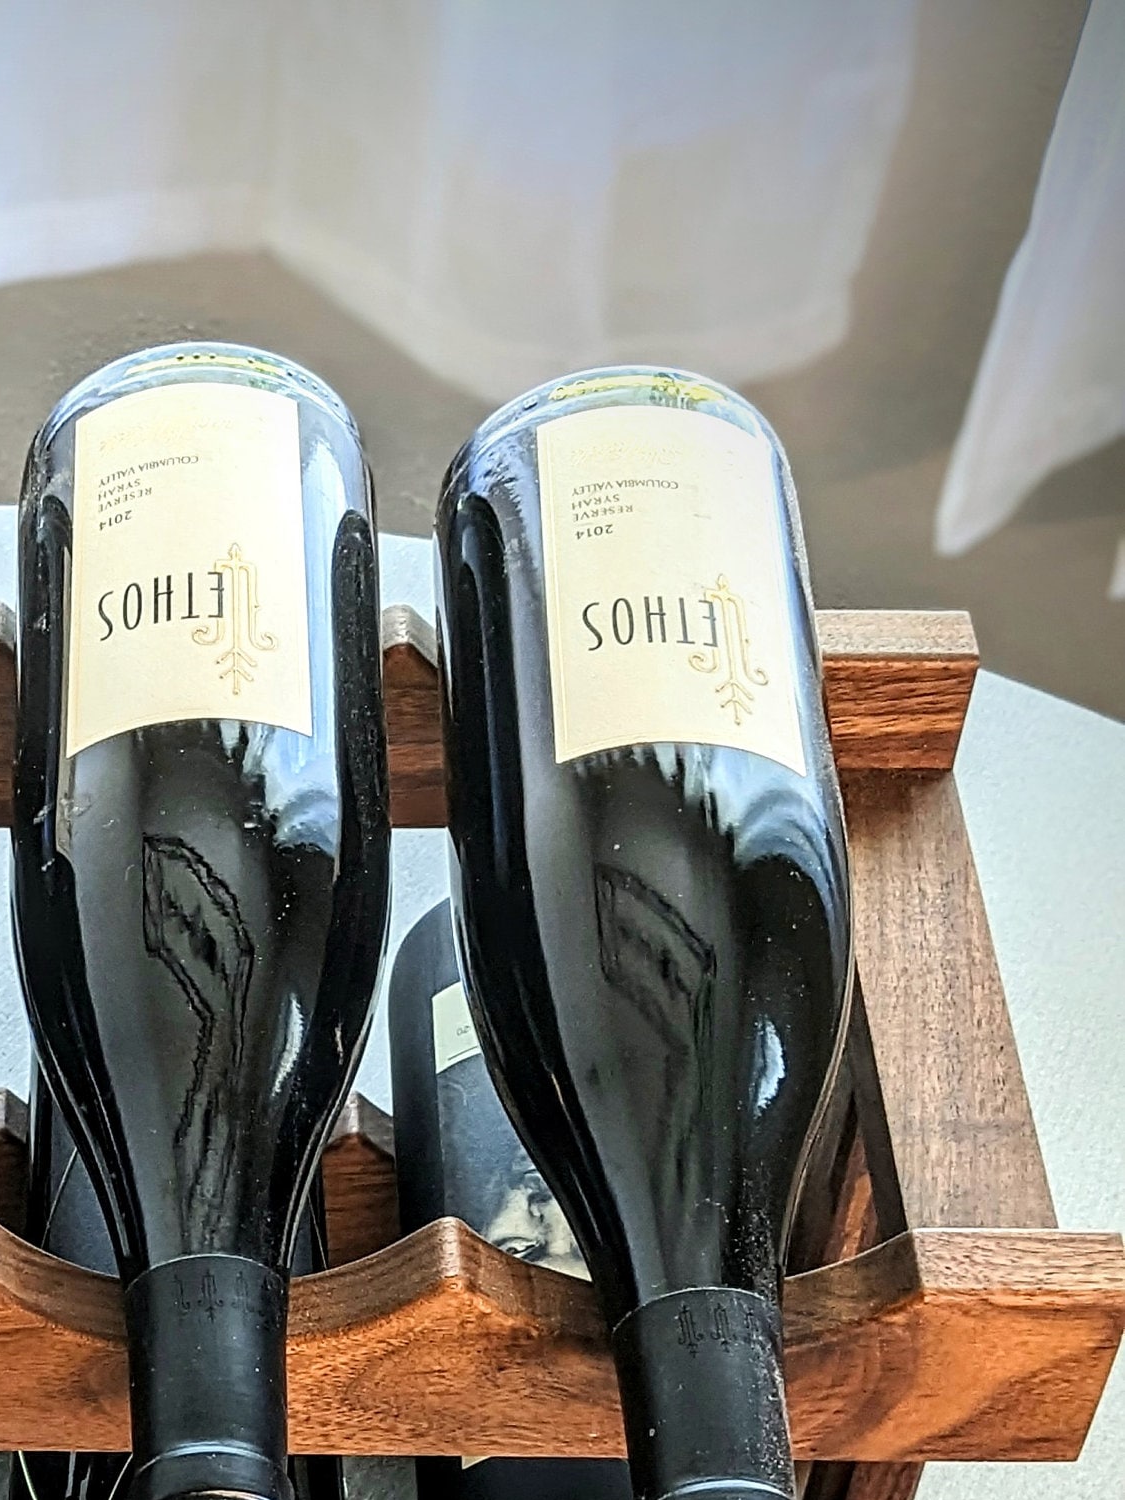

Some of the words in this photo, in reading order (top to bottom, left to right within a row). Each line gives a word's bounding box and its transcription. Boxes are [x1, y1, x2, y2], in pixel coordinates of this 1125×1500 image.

[138, 455, 199, 472] COLUMBIA
[98, 466, 136, 488] VALLEY
[615, 479, 679, 490] COLUMBIA
[98, 478, 141, 501] SYRAH
[572, 481, 614, 497] VALLEY
[98, 487, 153, 513] RESERVE
[571, 494, 620, 510] SYRAH
[98, 509, 133, 532] 2014
[572, 504, 634, 522] RESERVE
[575, 524, 614, 540] 2014
[97, 572, 225, 642] ETHOS
[581, 596, 719, 651] ETHOS
